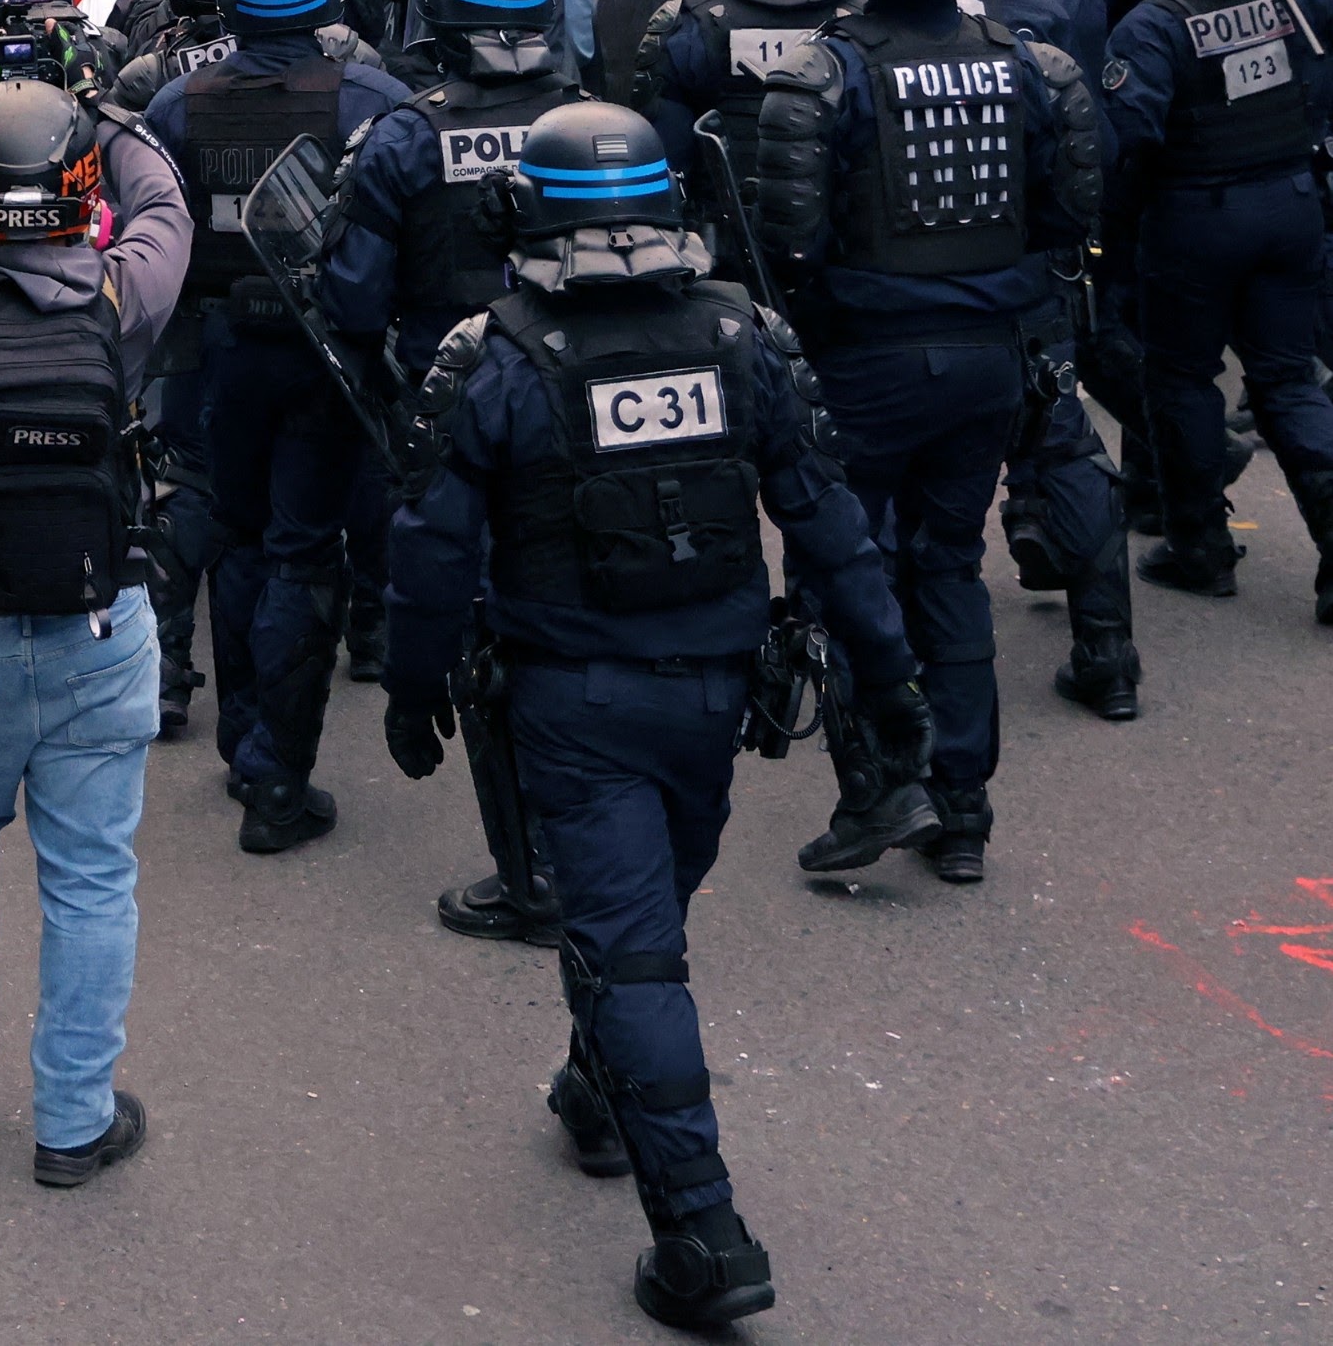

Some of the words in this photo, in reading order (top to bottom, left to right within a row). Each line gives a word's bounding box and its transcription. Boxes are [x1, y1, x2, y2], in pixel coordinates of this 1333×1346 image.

[893, 60, 1013, 99] POLICE
[1238, 55, 1277, 84] 123
[134, 123, 159, 147] GH6
[610, 390, 646, 433] C
[656, 382, 707, 430] 31
[13, 429, 82, 446] PRESS
